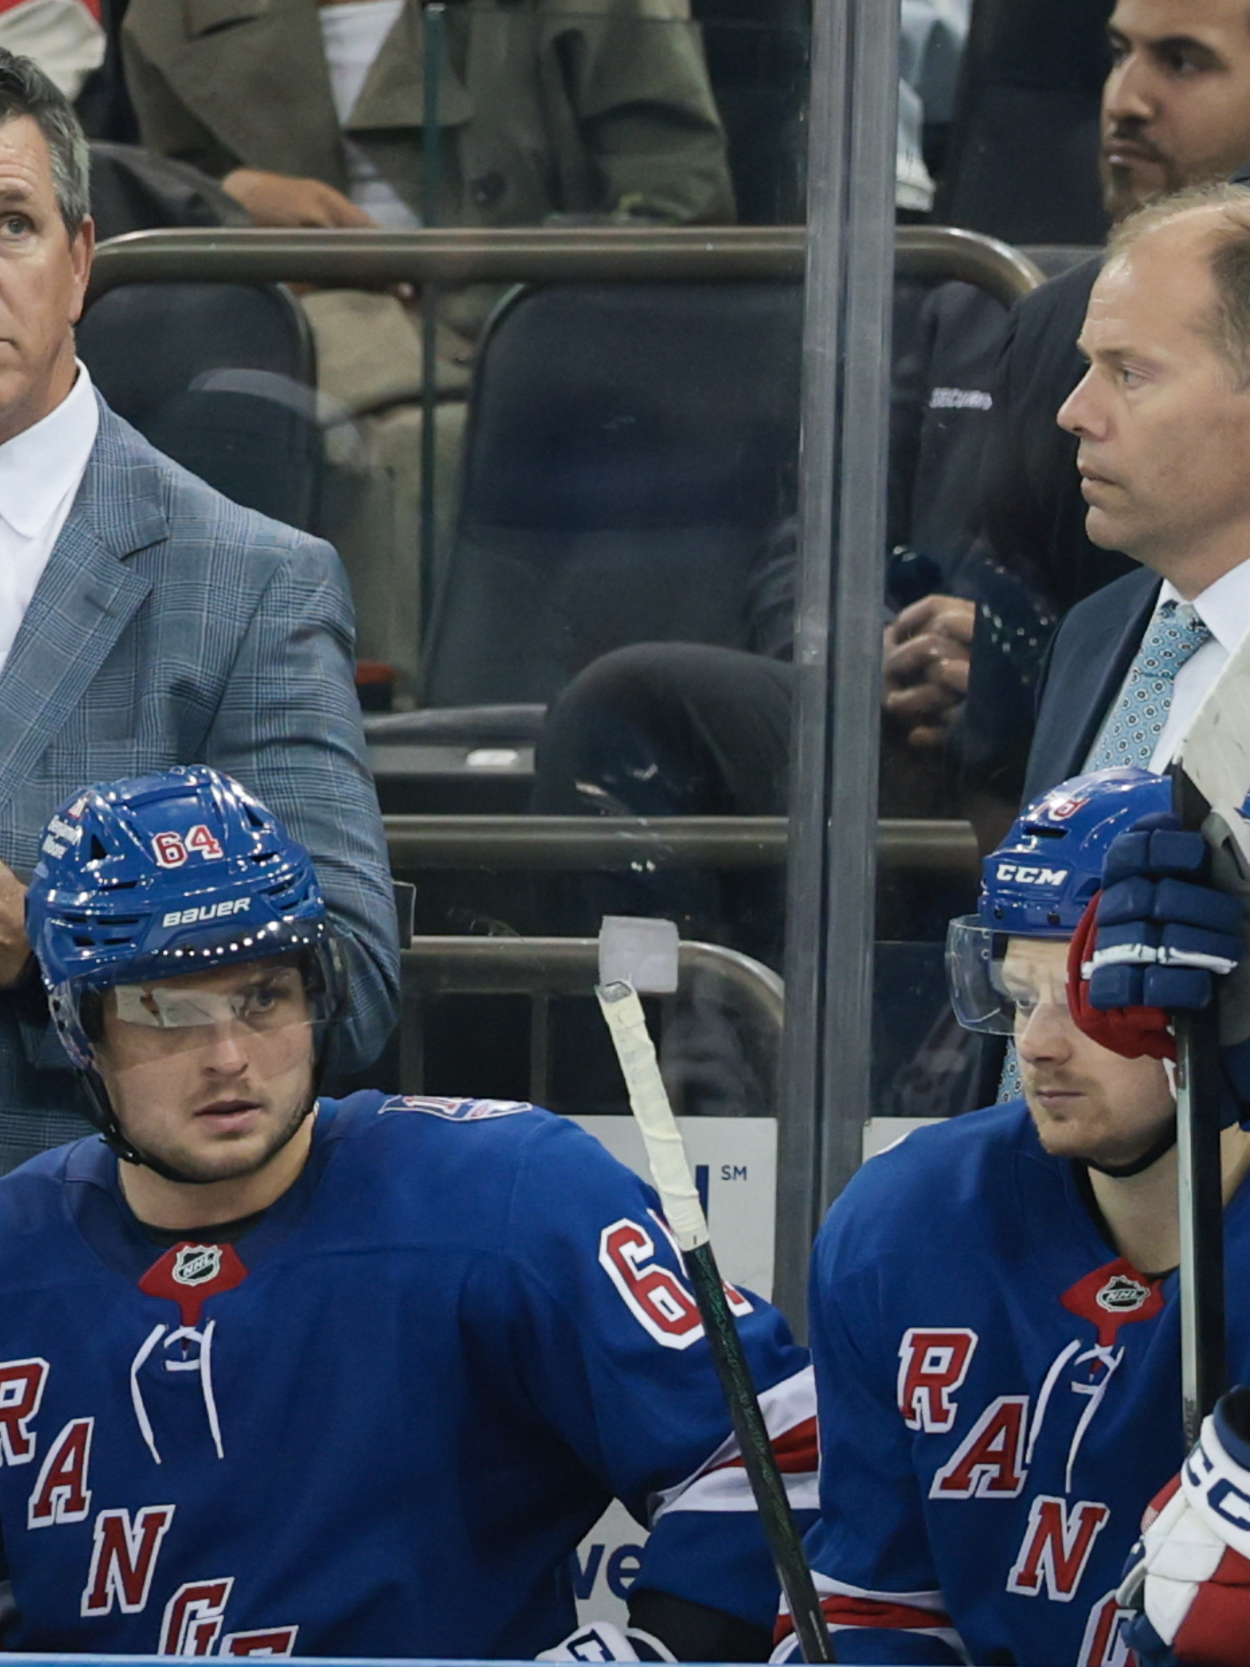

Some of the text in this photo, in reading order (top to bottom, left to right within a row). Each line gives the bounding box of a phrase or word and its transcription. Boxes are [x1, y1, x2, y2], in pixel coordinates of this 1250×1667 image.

[151, 824, 224, 869] 64
[996, 864, 1068, 886] CCM
[162, 897, 251, 928] BAUER
[720, 1164, 748, 1182] SM
[598, 1208, 755, 1350] 6
